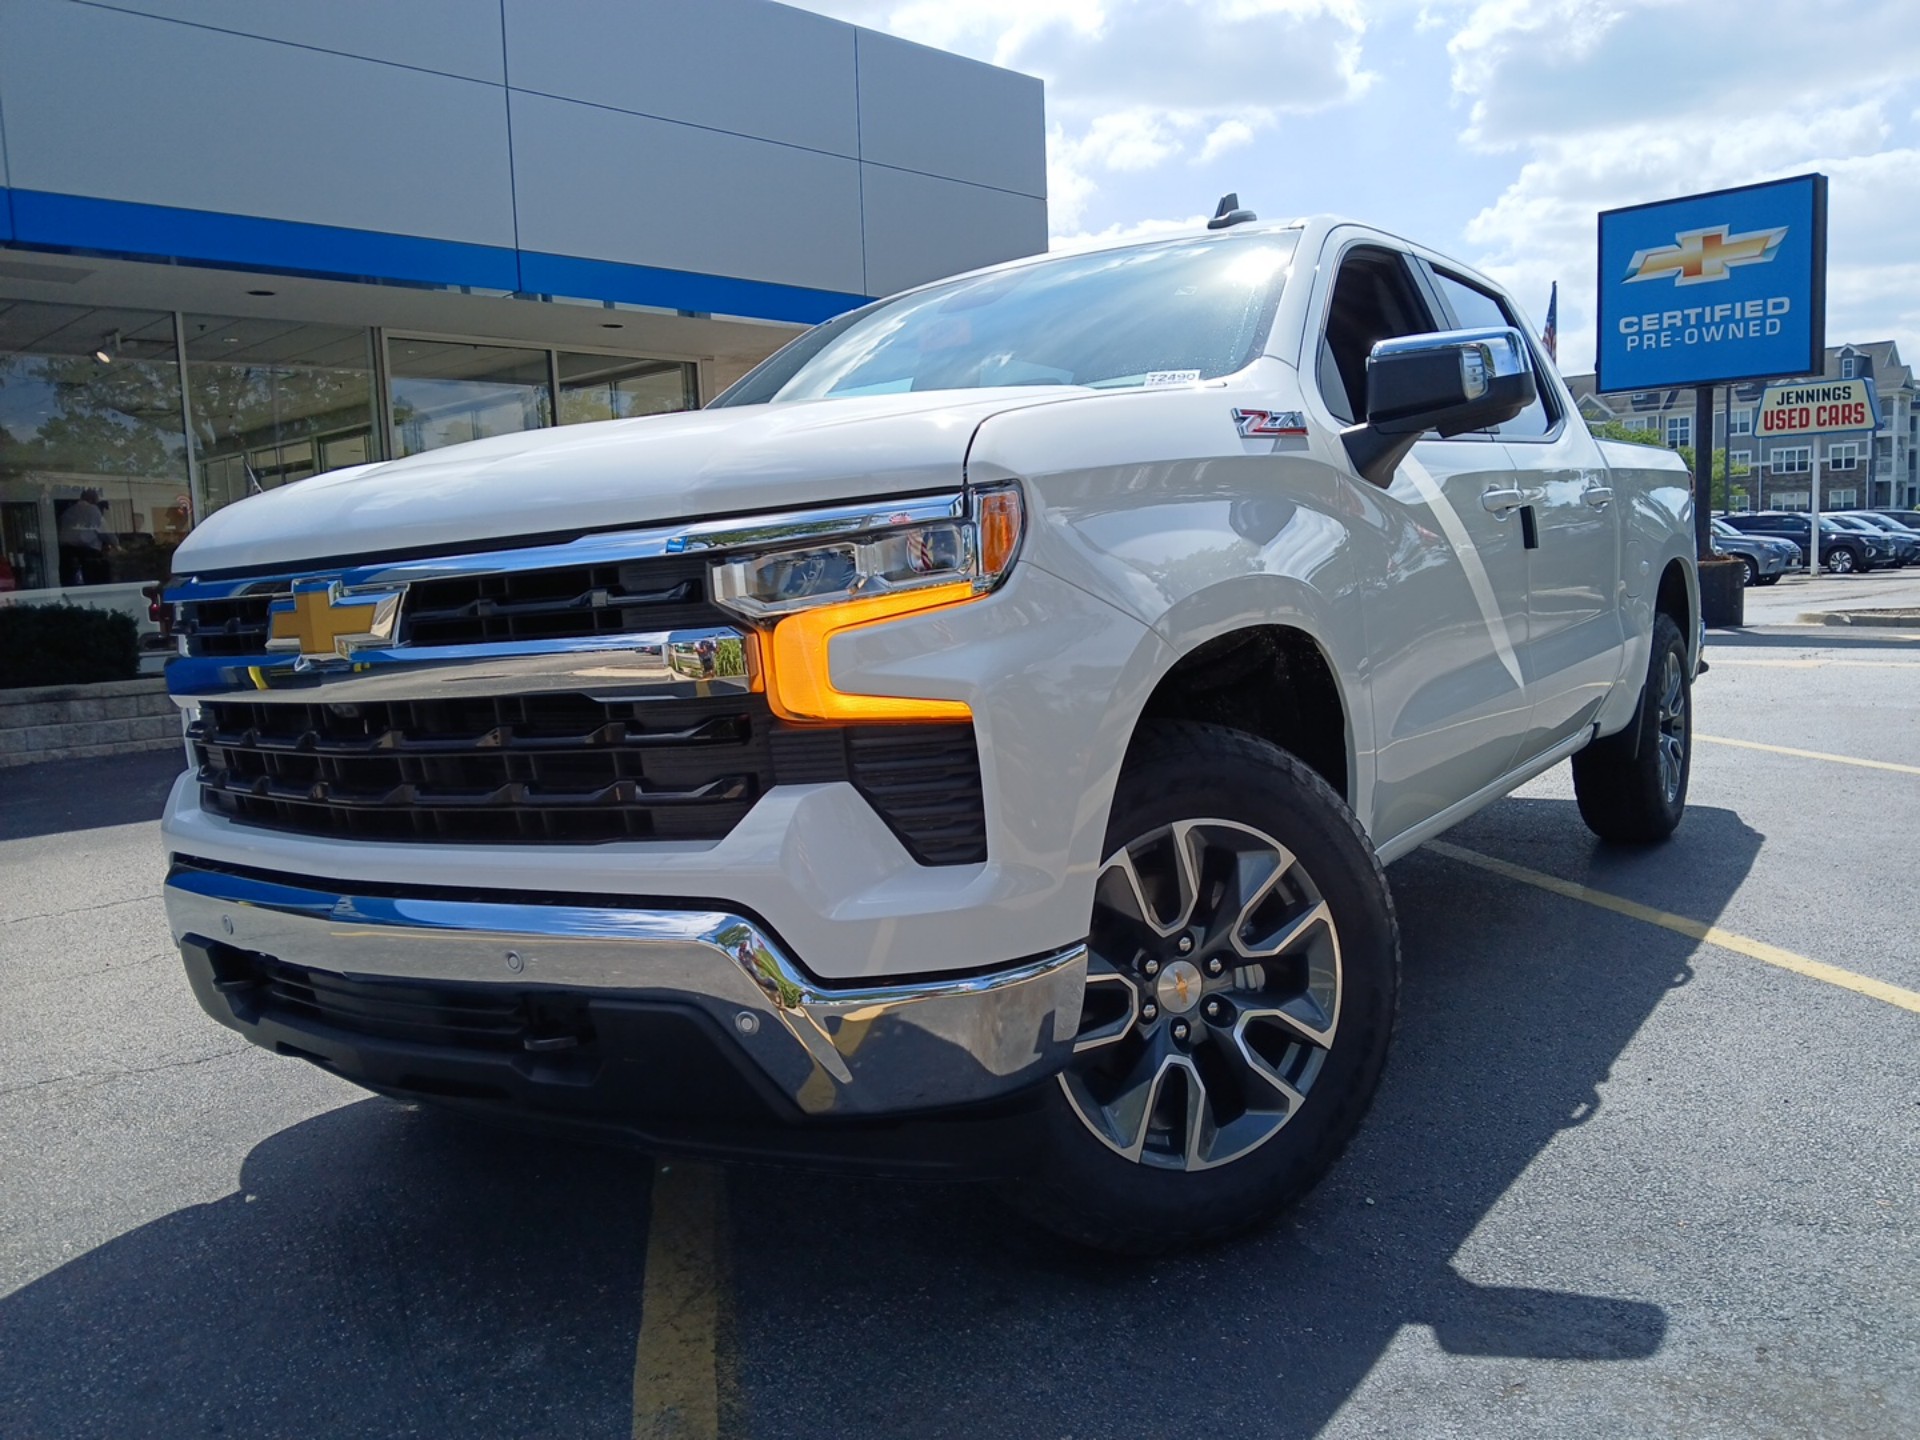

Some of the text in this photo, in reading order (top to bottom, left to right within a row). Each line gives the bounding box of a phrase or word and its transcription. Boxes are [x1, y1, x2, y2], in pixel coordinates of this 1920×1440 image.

[1619, 297, 1790, 334] CERTIFIED
[1627, 318, 1781, 352] PRE-OWNED
[1776, 386, 1852, 406] JENNINGS
[1231, 407, 1309, 440] Z71
[1763, 402, 1865, 431] USED CARS
